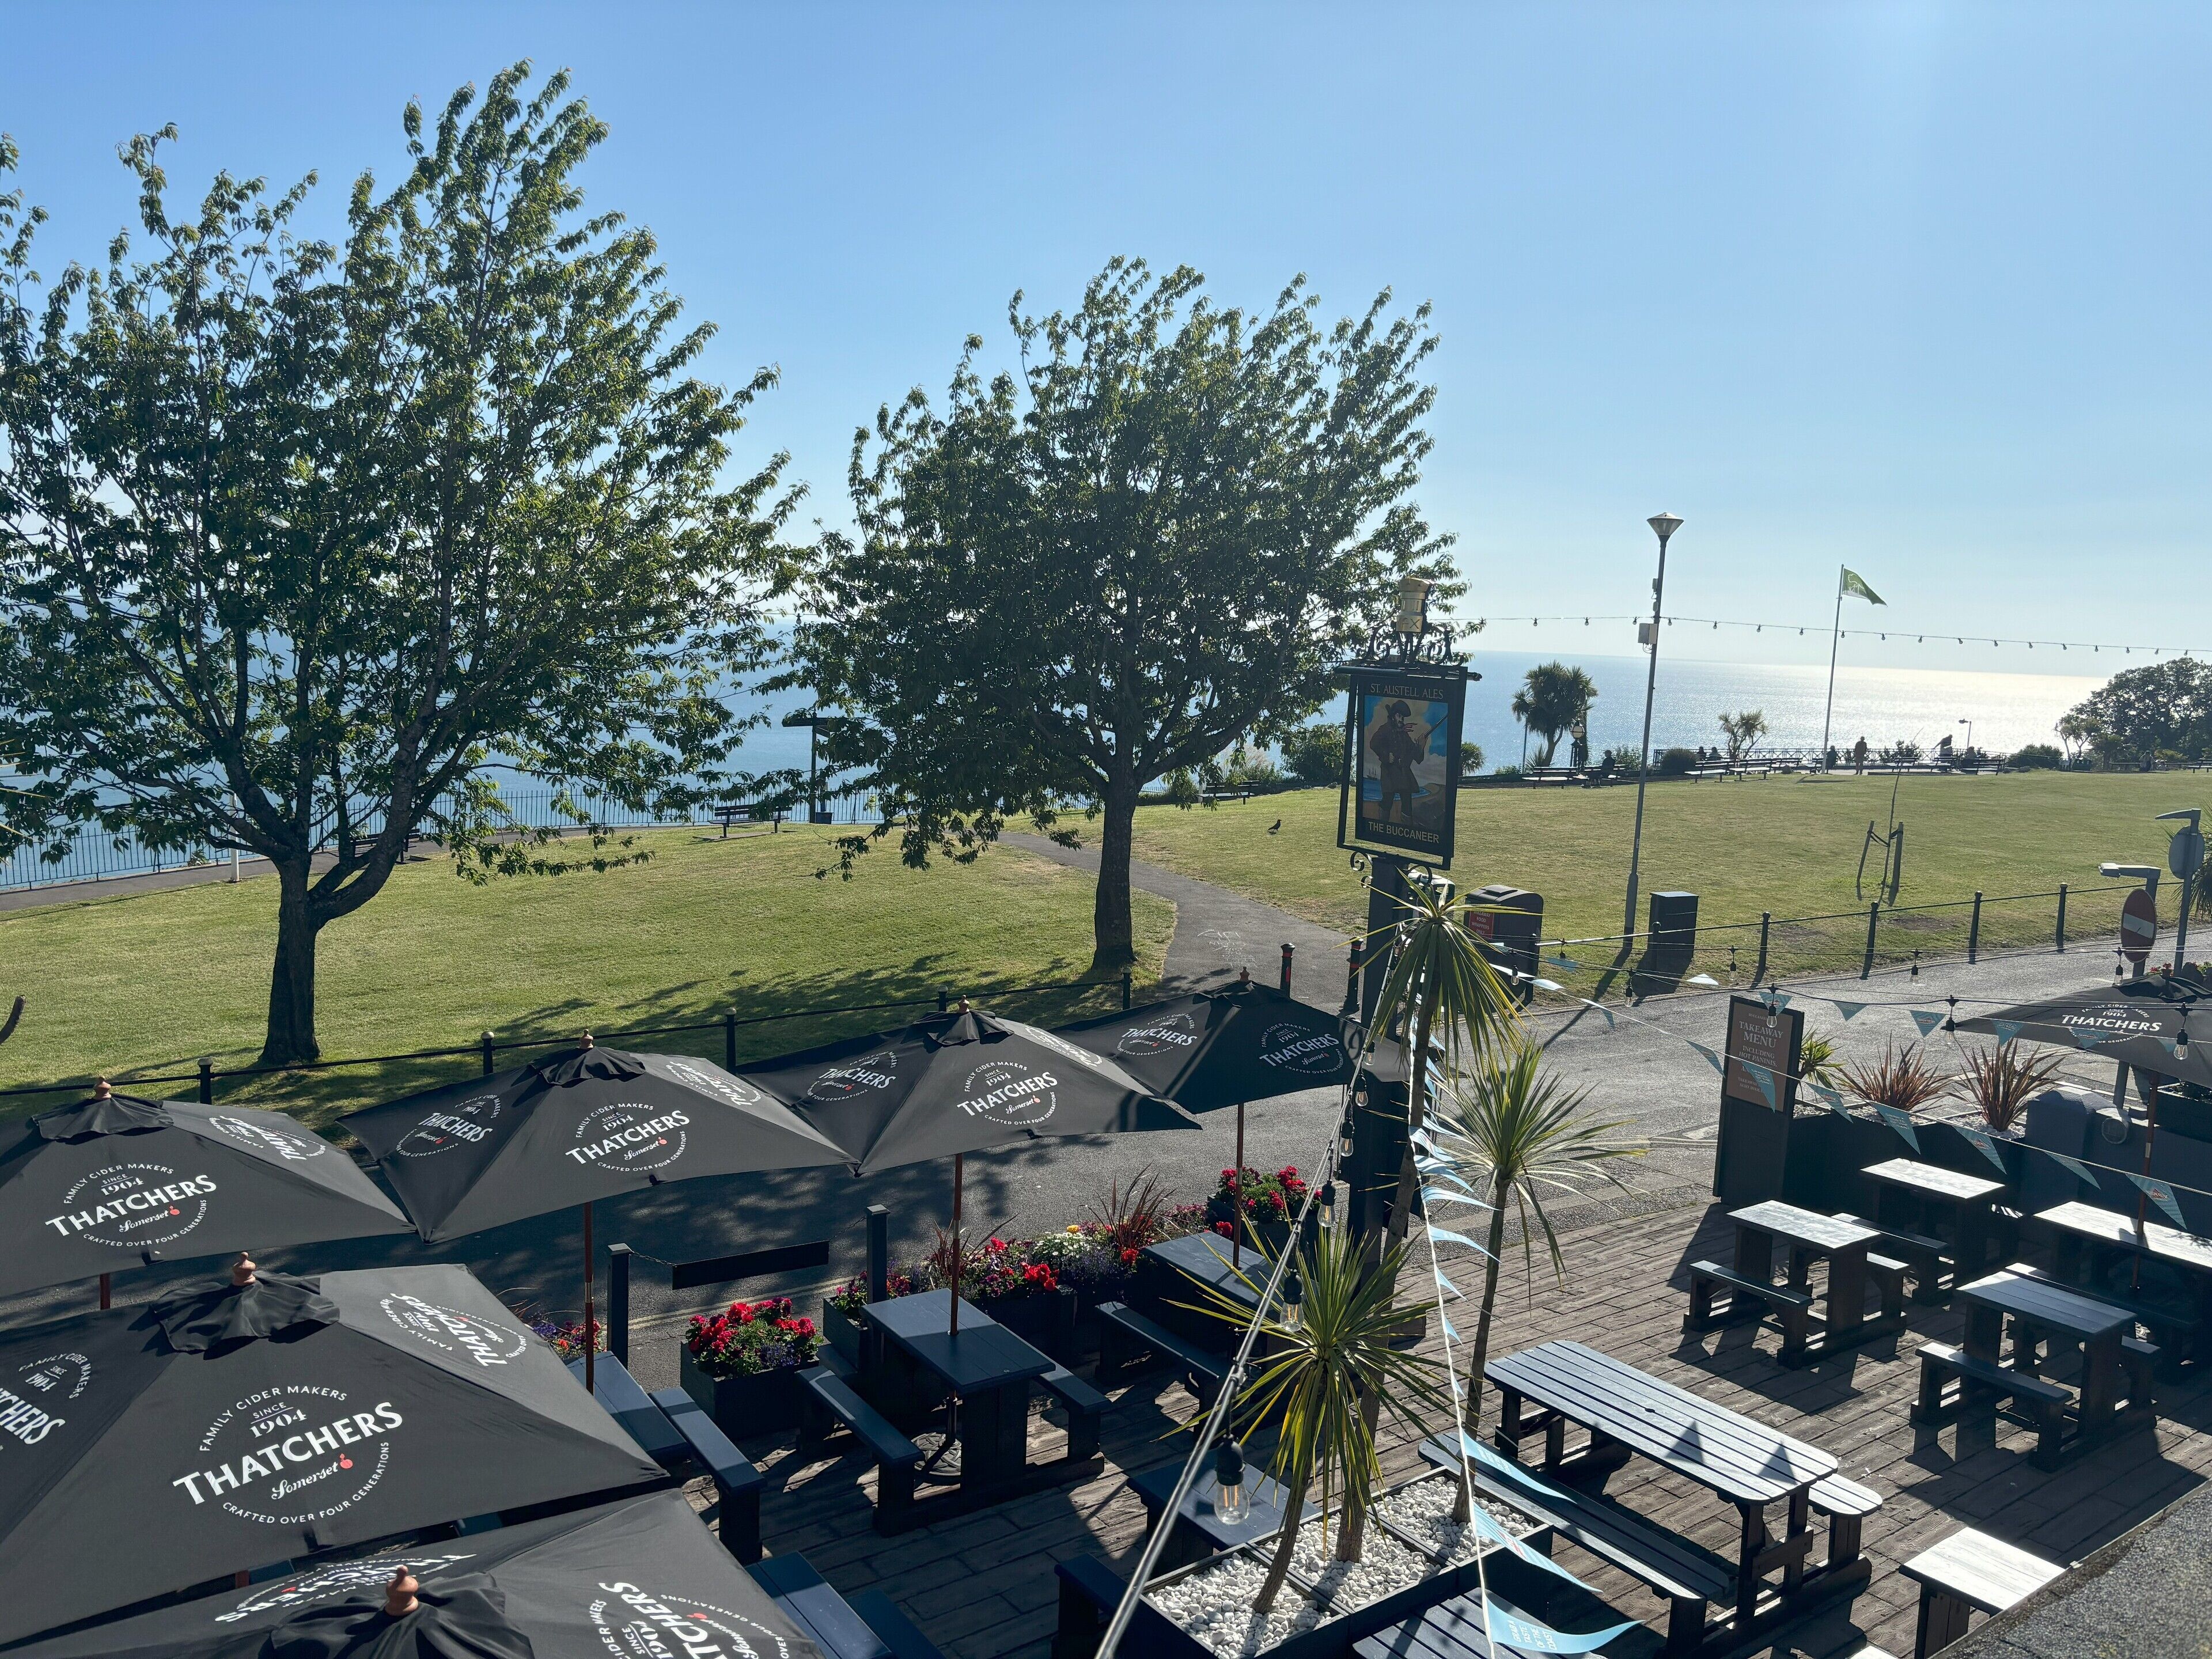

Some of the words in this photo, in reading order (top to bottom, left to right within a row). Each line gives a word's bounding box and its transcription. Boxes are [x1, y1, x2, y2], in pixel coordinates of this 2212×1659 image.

[1370, 683, 1381, 693] ST.
[1383, 685, 1419, 697] AUSTELL
[1422, 688, 1443, 699] ALES
[1368, 821, 1384, 832] THE
[1386, 825, 1439, 843] BUCCANEER
[1471, 922, 1489, 930] WRAPPERS
[1267, 1022, 1283, 1033] CIDER
[1739, 1021, 1783, 1039] TAKEAWAY
[2061, 1014, 2162, 1032] THATCHERS
[1122, 1028, 1198, 1046] THATCHERS
[1278, 1031, 1300, 1043] 1904
[1744, 1031, 1777, 1048] MENU
[1259, 1033, 1339, 1067] THATCHERS
[1738, 1051, 1751, 1060] HOT
[1743, 1045, 1775, 1059] INCLUDING
[818, 1067, 897, 1089] THATCHERS
[964, 1072, 976, 1092] FAMILY
[975, 1062, 995, 1073] CIDER
[997, 1061, 1028, 1071] MAKERS
[985, 1069, 1000, 1077] SINCE
[985, 1072, 1012, 1086] 1904
[956, 1071, 1058, 1116] THATCHERS
[1005, 1098, 1034, 1114] Somerset
[575, 1116, 592, 1138] FAMILY
[590, 1104, 616, 1118] CIDER
[618, 1103, 654, 1111] MAKERS
[601, 1112, 622, 1122] SINCE
[602, 1114, 634, 1132] 1904
[984, 1114, 1012, 1125] CRAFTED
[418, 1112, 494, 1142] THATCHERS
[565, 1110, 690, 1164] THATCHERS
[410, 1142, 459, 1157] GENERATIONS
[597, 1162, 630, 1172] CRAFTED
[654, 1159, 672, 1168] FOUR
[671, 1131, 687, 1161] GENERATIONS
[624, 1141, 660, 1161] Somerset
[63, 1177, 88, 1205] FAMILY
[89, 1165, 124, 1179] CIDER
[127, 1163, 174, 1175] MAKERS
[100, 1177, 145, 1196] 1904
[102, 1173, 128, 1185] SINCE
[44, 1175, 217, 1237] THATCHERS
[83, 1233, 123, 1247] CRAFTED
[155, 1233, 179, 1244] FOUR
[179, 1199, 207, 1235] GENERATIONS
[119, 1210, 169, 1233] Somerset
[390, 1293, 508, 1366] THATCHERS
[407, 1330, 453, 1351] FAMILY
[18, 1353, 67, 1372] FAMILY
[65, 1353, 88, 1365] CIDER
[69, 1363, 92, 1399] MAKERS
[199, 1409, 233, 1452] FAMILY
[236, 1387, 282, 1411] CIDER
[287, 1385, 347, 1402] MAKERS
[252, 1402, 287, 1419] SINCE
[249, 1409, 308, 1438] 1904
[172, 1402, 403, 1505] THATCHERS
[222, 1501, 275, 1524] CRAFTED
[279, 1513, 316, 1524] OVER
[319, 1500, 351, 1518] FOUR
[352, 1442, 390, 1502] GENERATIONS
[271, 1461, 338, 1501] Somerset
[621, 1627, 646, 1655] SINCE
[1518, 1624, 1533, 1643] TASTE
[1530, 1627, 1541, 1639] THE
[1541, 1630, 1558, 1650] COAST
[775, 1635, 790, 1659] OVER
[1535, 1638, 1546, 1648] OF
